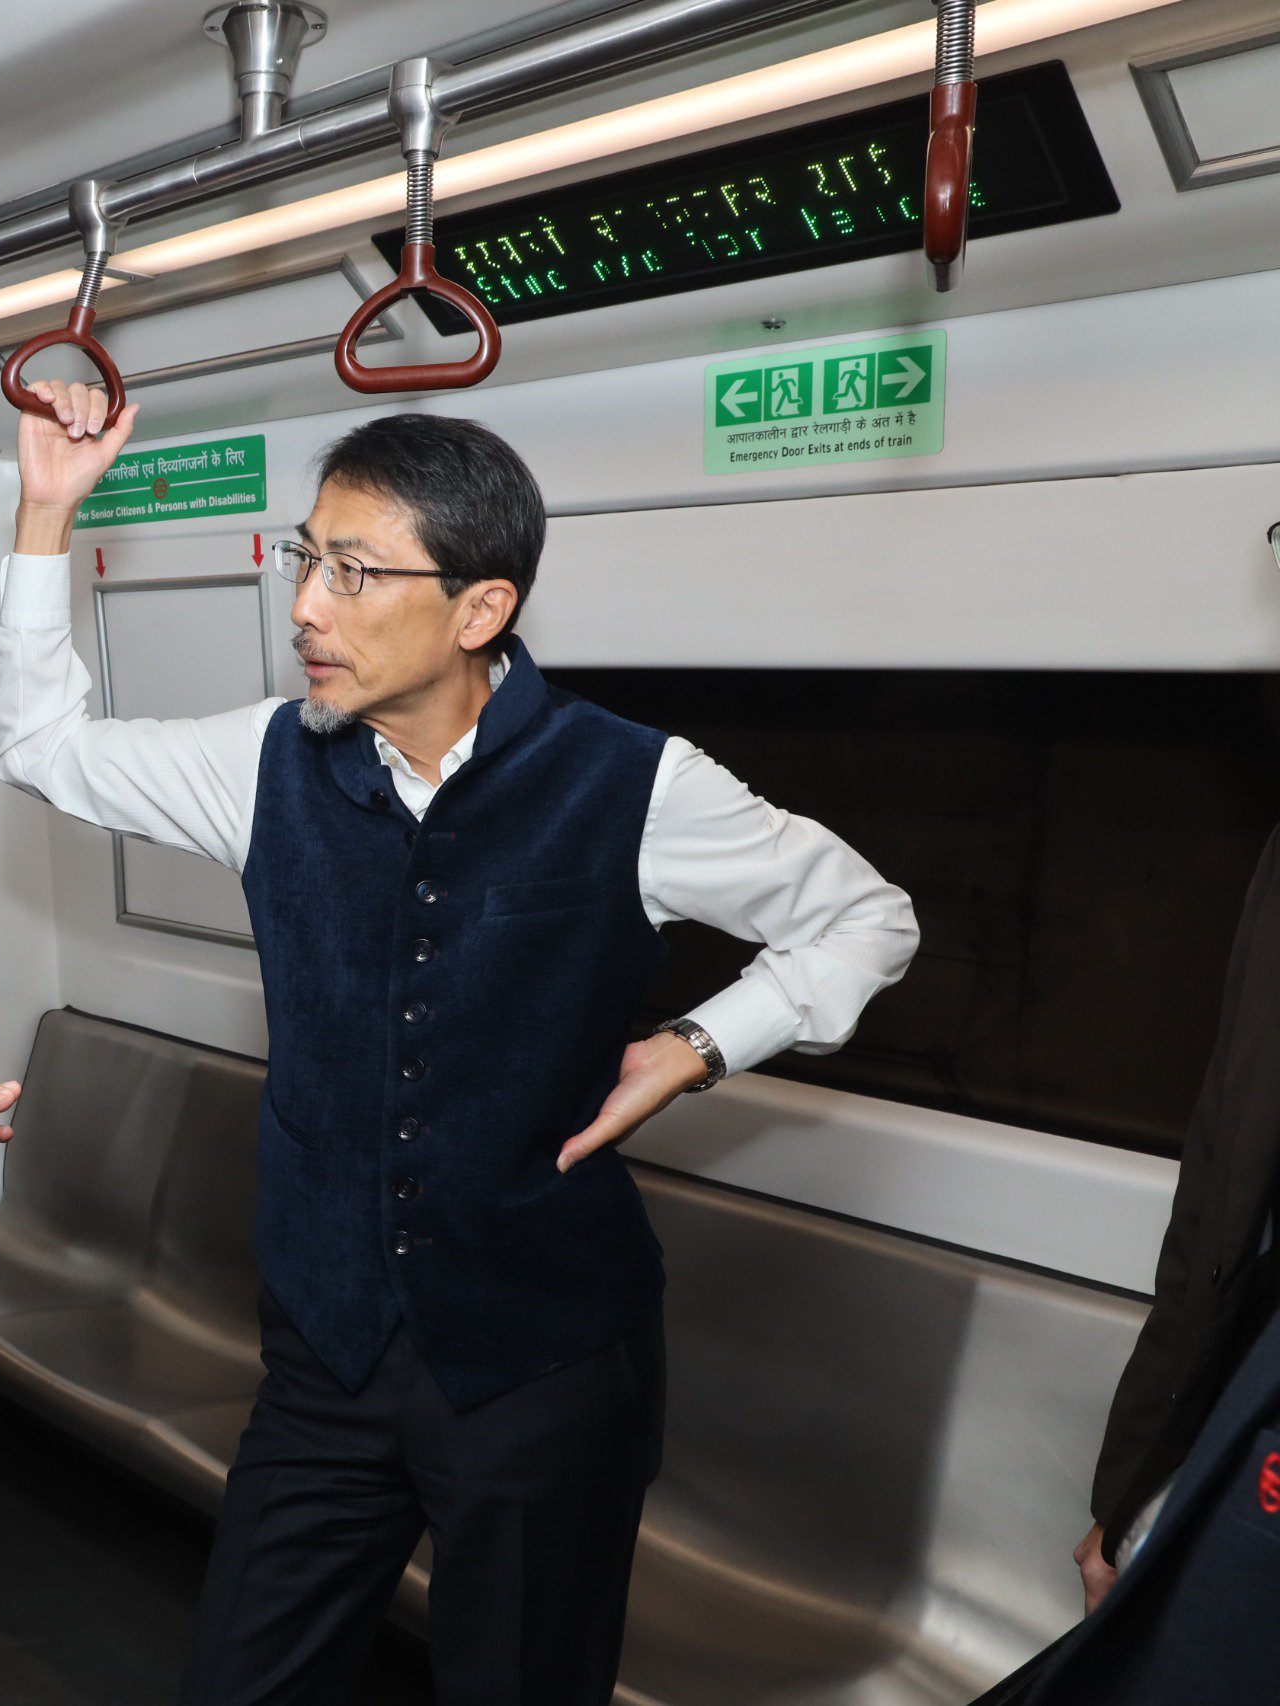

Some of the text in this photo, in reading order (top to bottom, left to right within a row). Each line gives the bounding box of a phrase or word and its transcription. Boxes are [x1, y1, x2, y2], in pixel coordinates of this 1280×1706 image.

[727, 410, 917, 443] आपातकालीन द्वार रेलगाड़ी के अंत में है
[730, 435, 912, 462] Emergency Door Exits at ends of train
[105, 447, 245, 481] नागरिकों एवं दिव्यांगजनों के लिए
[77, 493, 256, 521] For Senior Citizens & Persons with Disabilities
